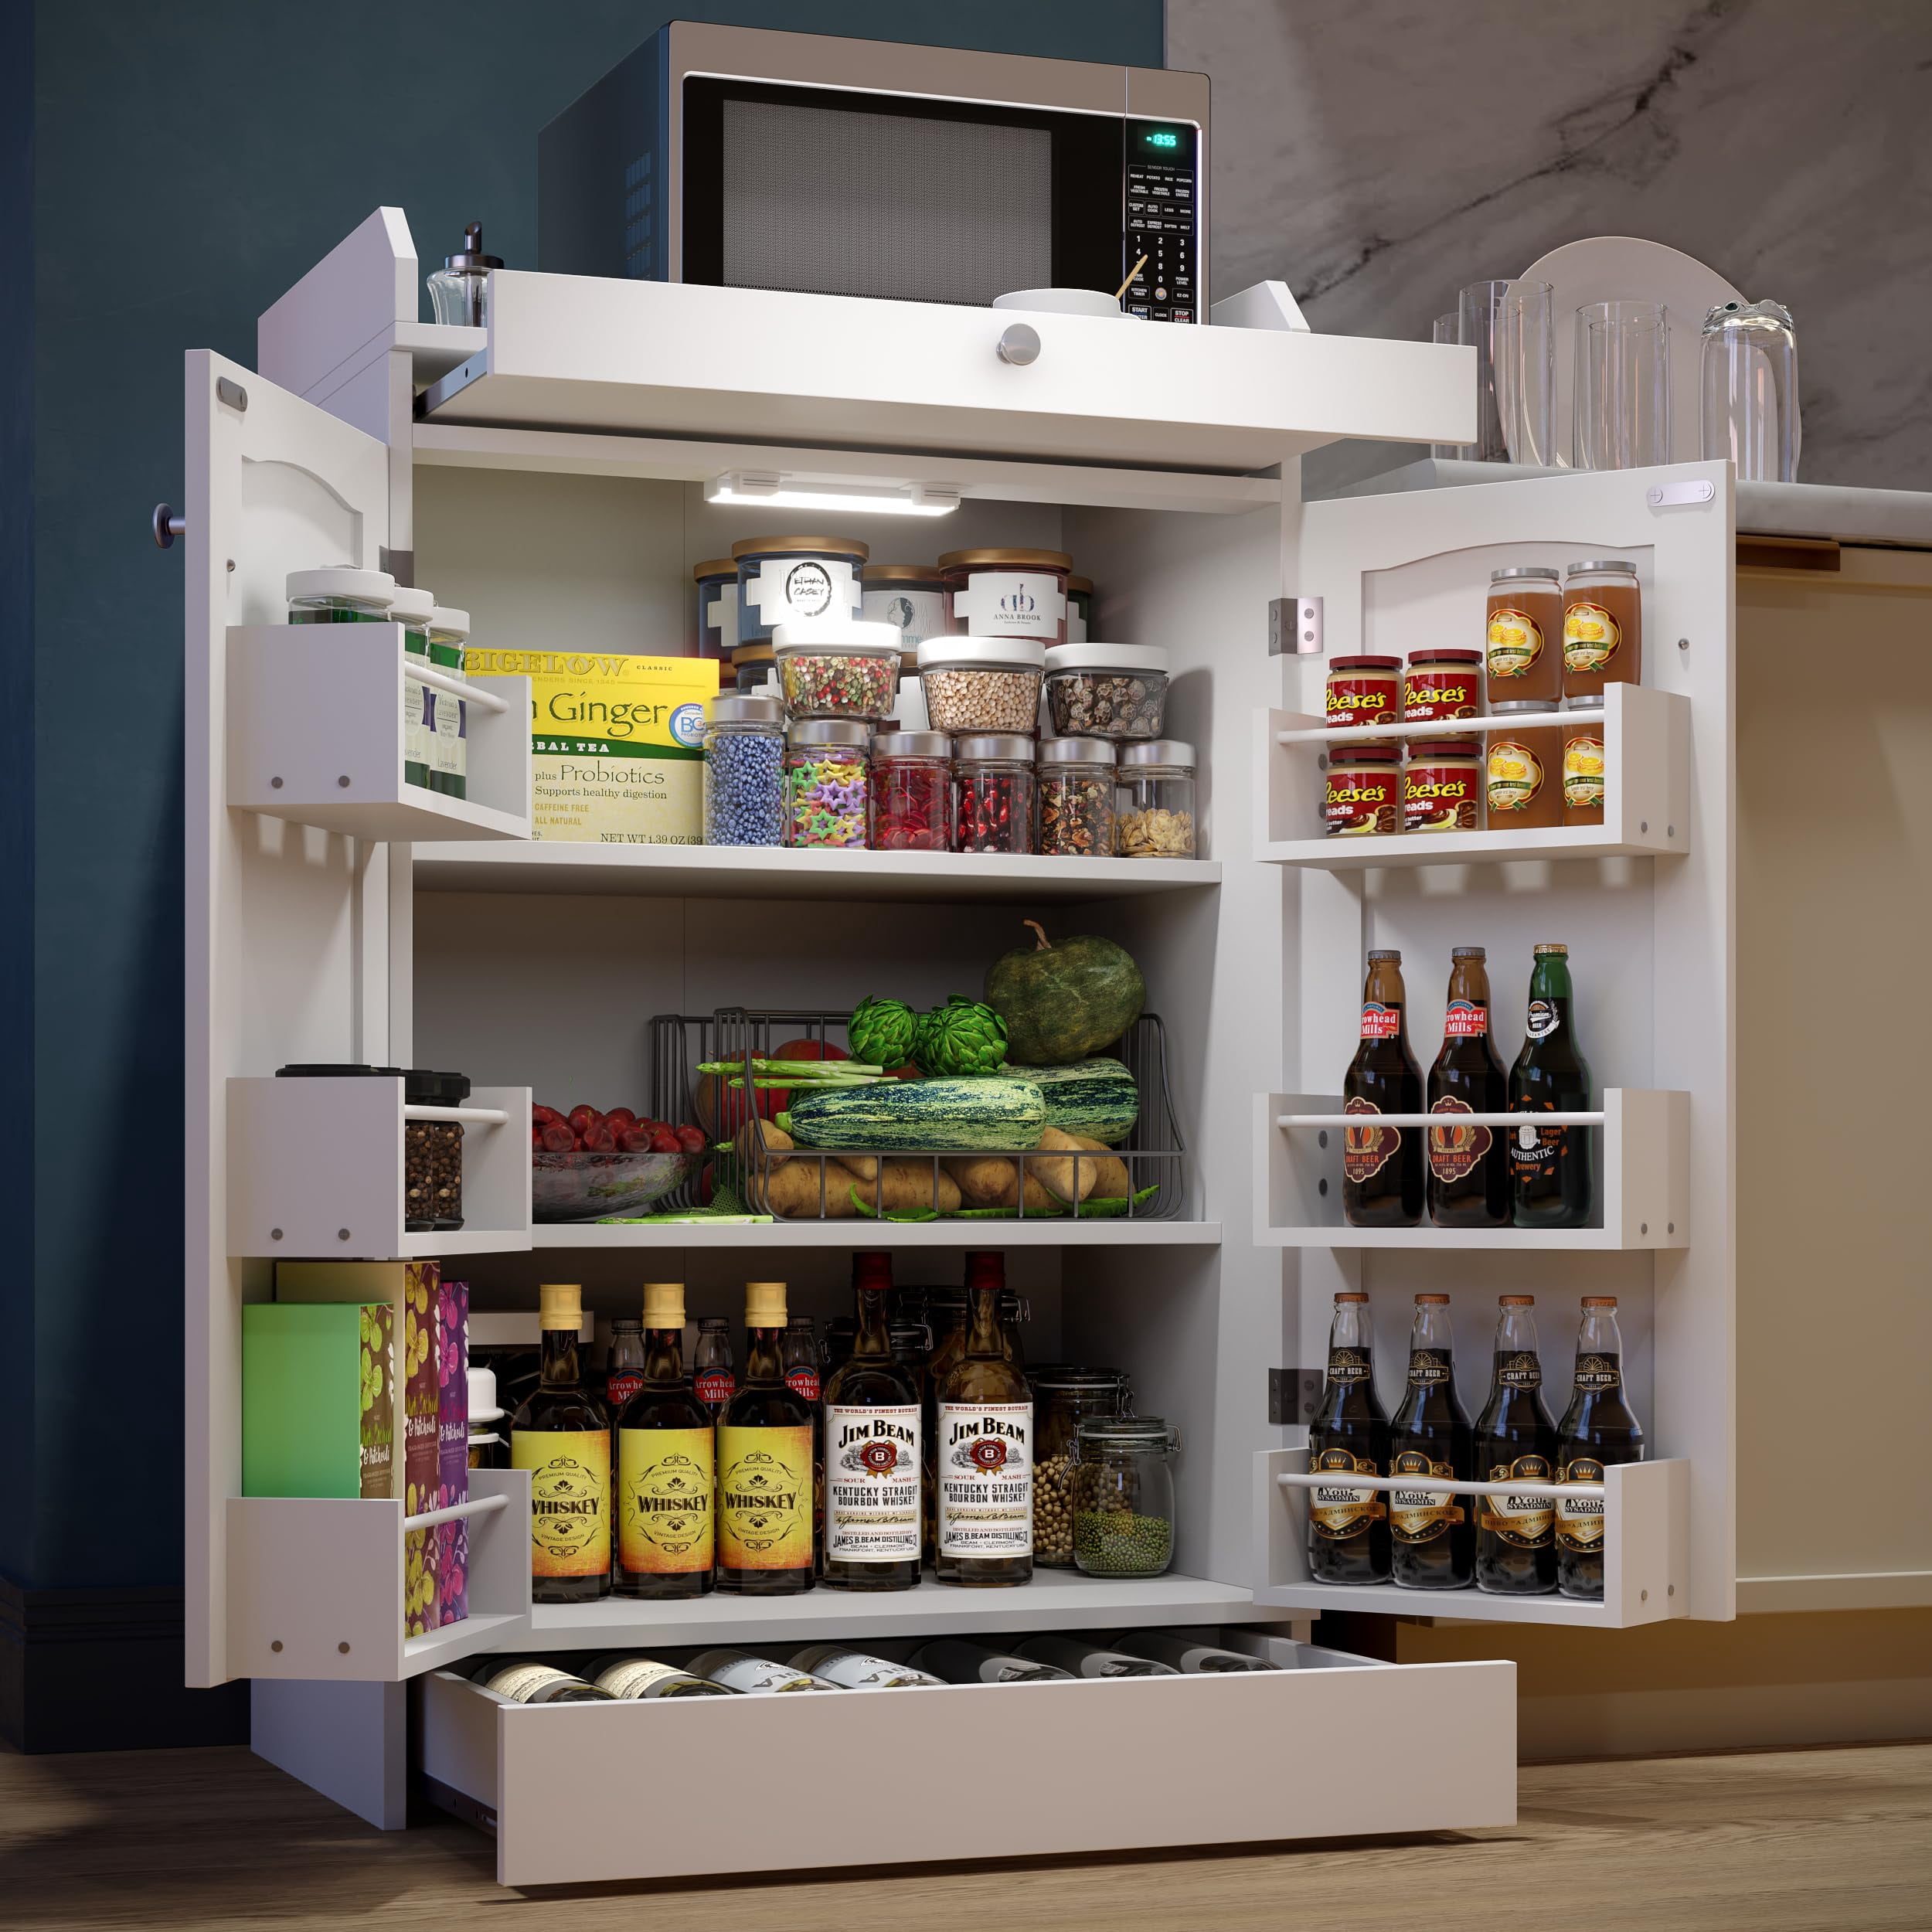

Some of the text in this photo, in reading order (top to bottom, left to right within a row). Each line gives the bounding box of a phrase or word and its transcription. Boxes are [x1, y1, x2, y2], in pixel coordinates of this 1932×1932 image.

[794, 587, 824, 597] CASEY
[465, 651, 629, 676] BIGELOW
[549, 691, 668, 737] Ginger
[577, 743, 610, 753] TEA
[535, 760, 665, 784] plus Probiotics
[535, 786, 667, 800] Supports healthy digestion
[535, 803, 590, 812] CAFFEINE FREE
[550, 817, 582, 825] NATURAL
[600, 833, 624, 842] NET
[627, 834, 646, 843] WT
[648, 835, 668, 844] 1.39
[670, 836, 685, 845] OZ
[1447, 1022, 1472, 1033] Mills
[1540, 1127, 1561, 1138] Lager
[1542, 1138, 1560, 1146] Beer
[1511, 1145, 1554, 1162] AUTHENTIC
[1515, 1162, 1541, 1172] Brewery
[704, 1389, 730, 1399] Mills
[408, 1418, 414, 1437] &
[440, 1425, 445, 1441] &
[949, 1417, 1025, 1446] JIM BEAM
[838, 1420, 914, 1448] JIM BEAM
[363, 1448, 369, 1465] &
[875, 1452, 885, 1461] B
[985, 1449, 995, 1458] B
[538, 1471, 587, 1481] PREMIUM QUALITY
[651, 1469, 677, 1478] PREMIUM
[735, 1467, 783, 1475] PREMIUM QUALITY
[833, 1485, 917, 1496] KENTUCKY STRAIGHT
[944, 1482, 1029, 1493] KENTUCKY STRAIGHT
[637, 1493, 709, 1513] WHISKEY
[725, 1492, 797, 1510] WHISKEY
[838, 1497, 879, 1506] BOURBON
[949, 1493, 988, 1503] BOURBON
[541, 1533, 585, 1542] VINTAGE DESIGN
[654, 1530, 696, 1539] VINTAGE DESIGN
[944, 1532, 963, 1544] JAMES
[991, 1531, 1023, 1541] DISTILLING
[833, 1535, 853, 1548] JAMES
[882, 1535, 913, 1546] DISTILLING
